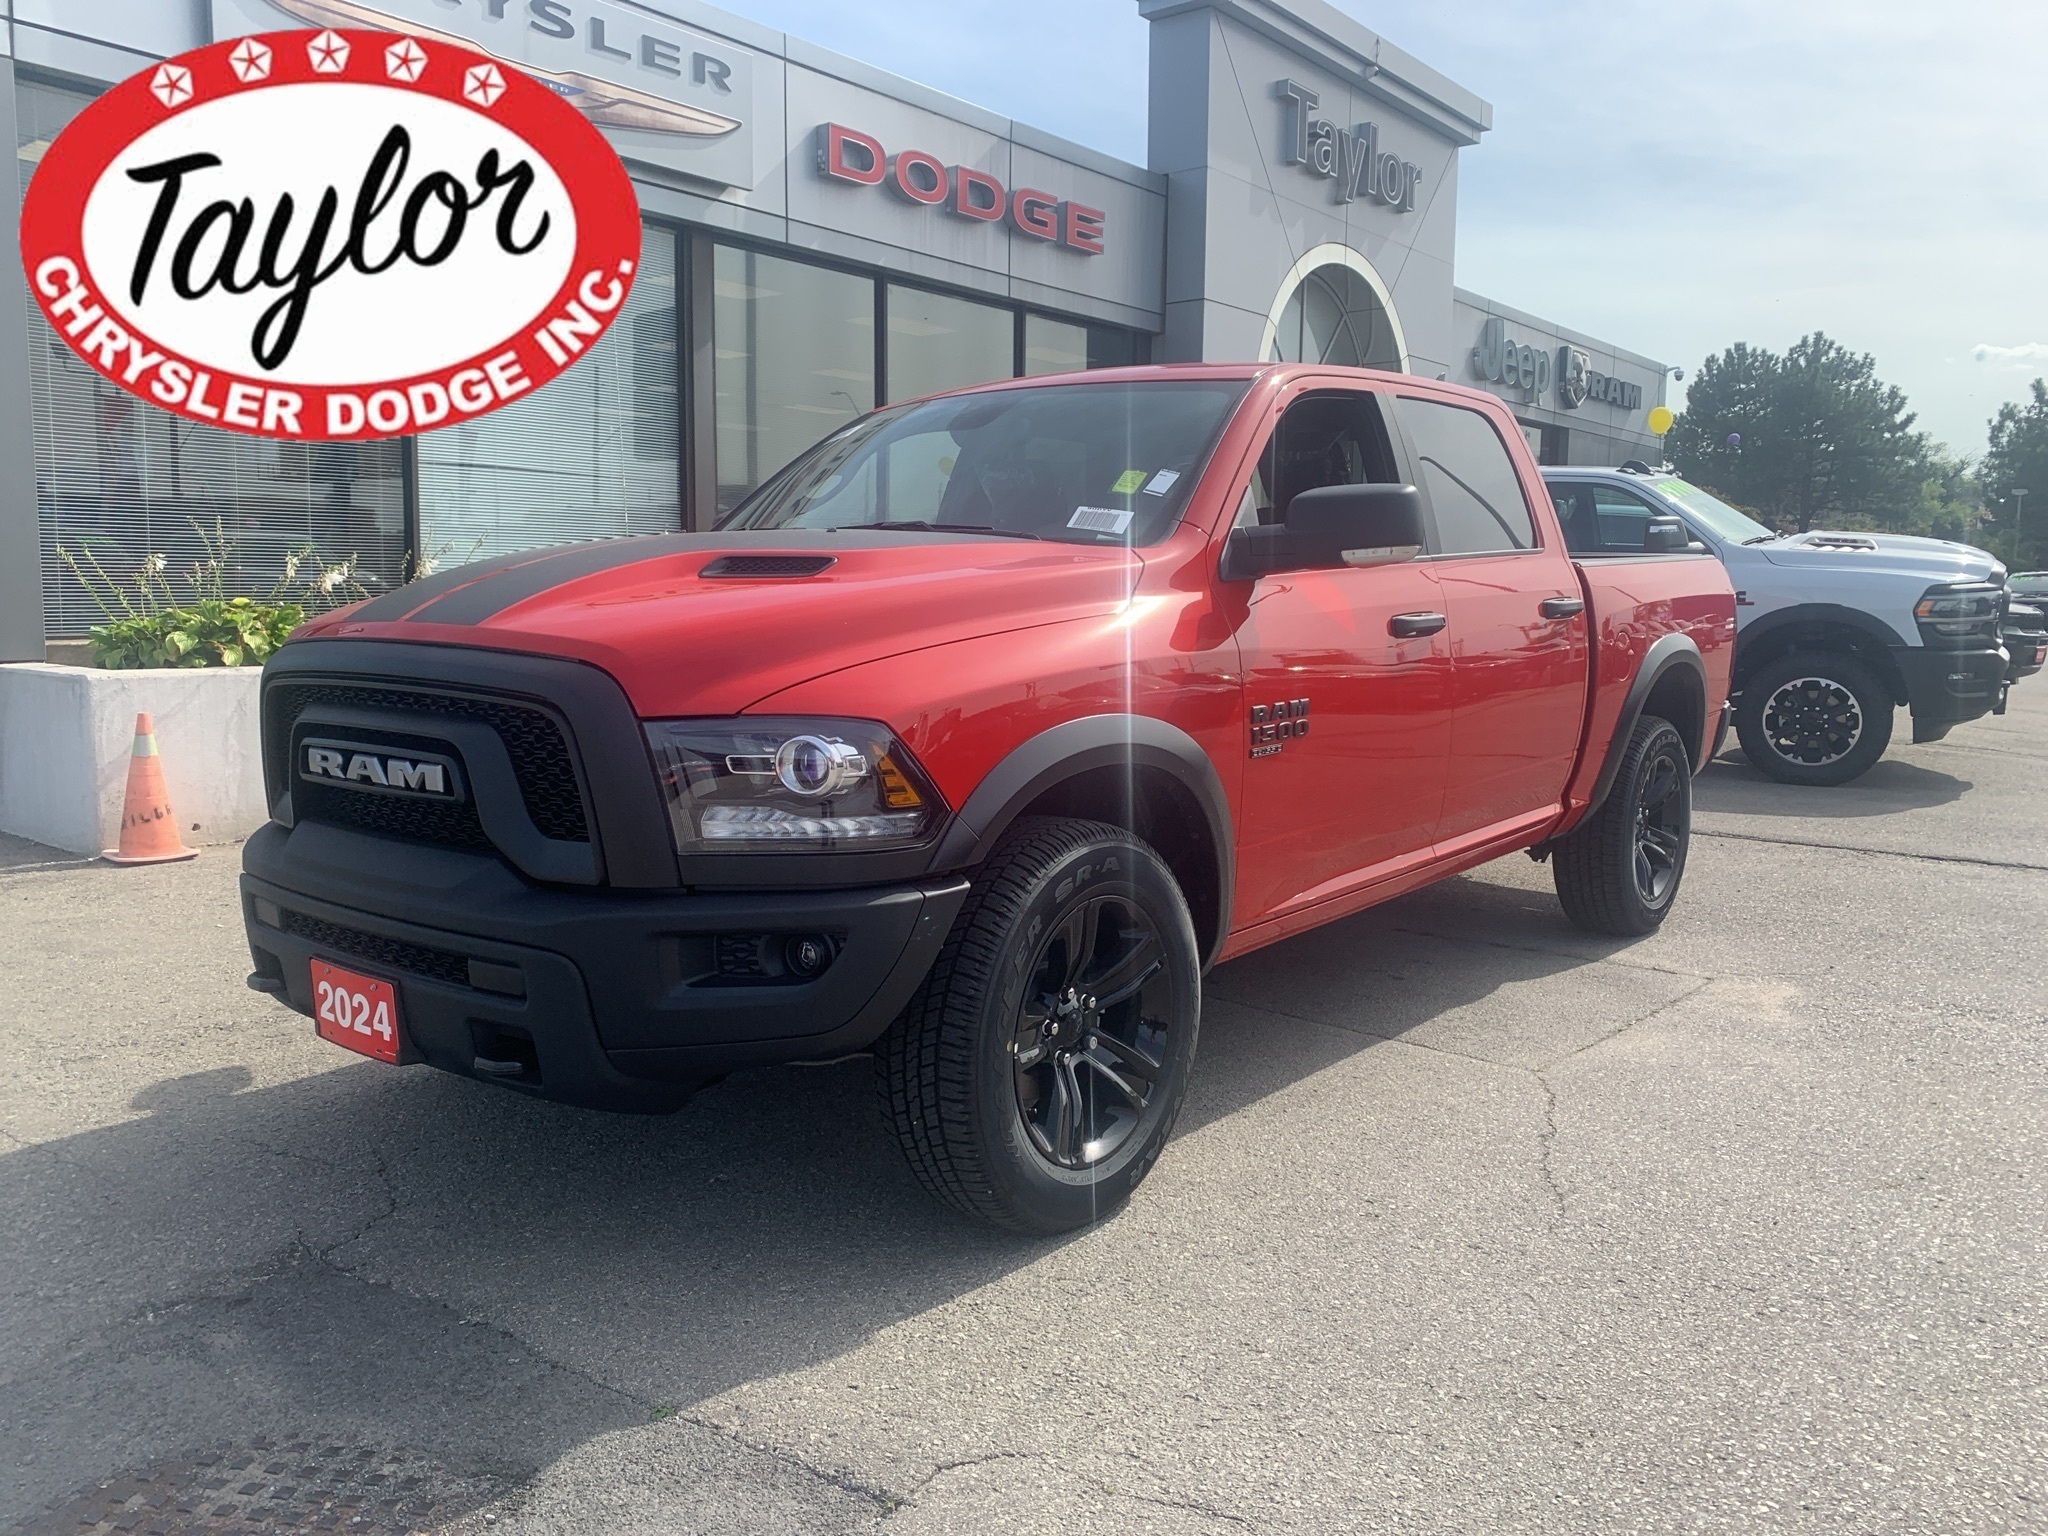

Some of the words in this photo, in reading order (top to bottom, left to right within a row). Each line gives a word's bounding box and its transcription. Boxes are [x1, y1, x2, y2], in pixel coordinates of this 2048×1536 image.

[441, 0, 732, 93] SLER
[1276, 77, 1423, 213] Taylor
[816, 121, 1106, 256] DODGE
[1474, 317, 1550, 407] Jeep
[1591, 371, 1642, 410] RAM
[1250, 697, 1310, 725] RAM
[1250, 718, 1309, 746] 1500
[307, 746, 445, 793] RAM
[317, 980, 392, 1041] 2024
